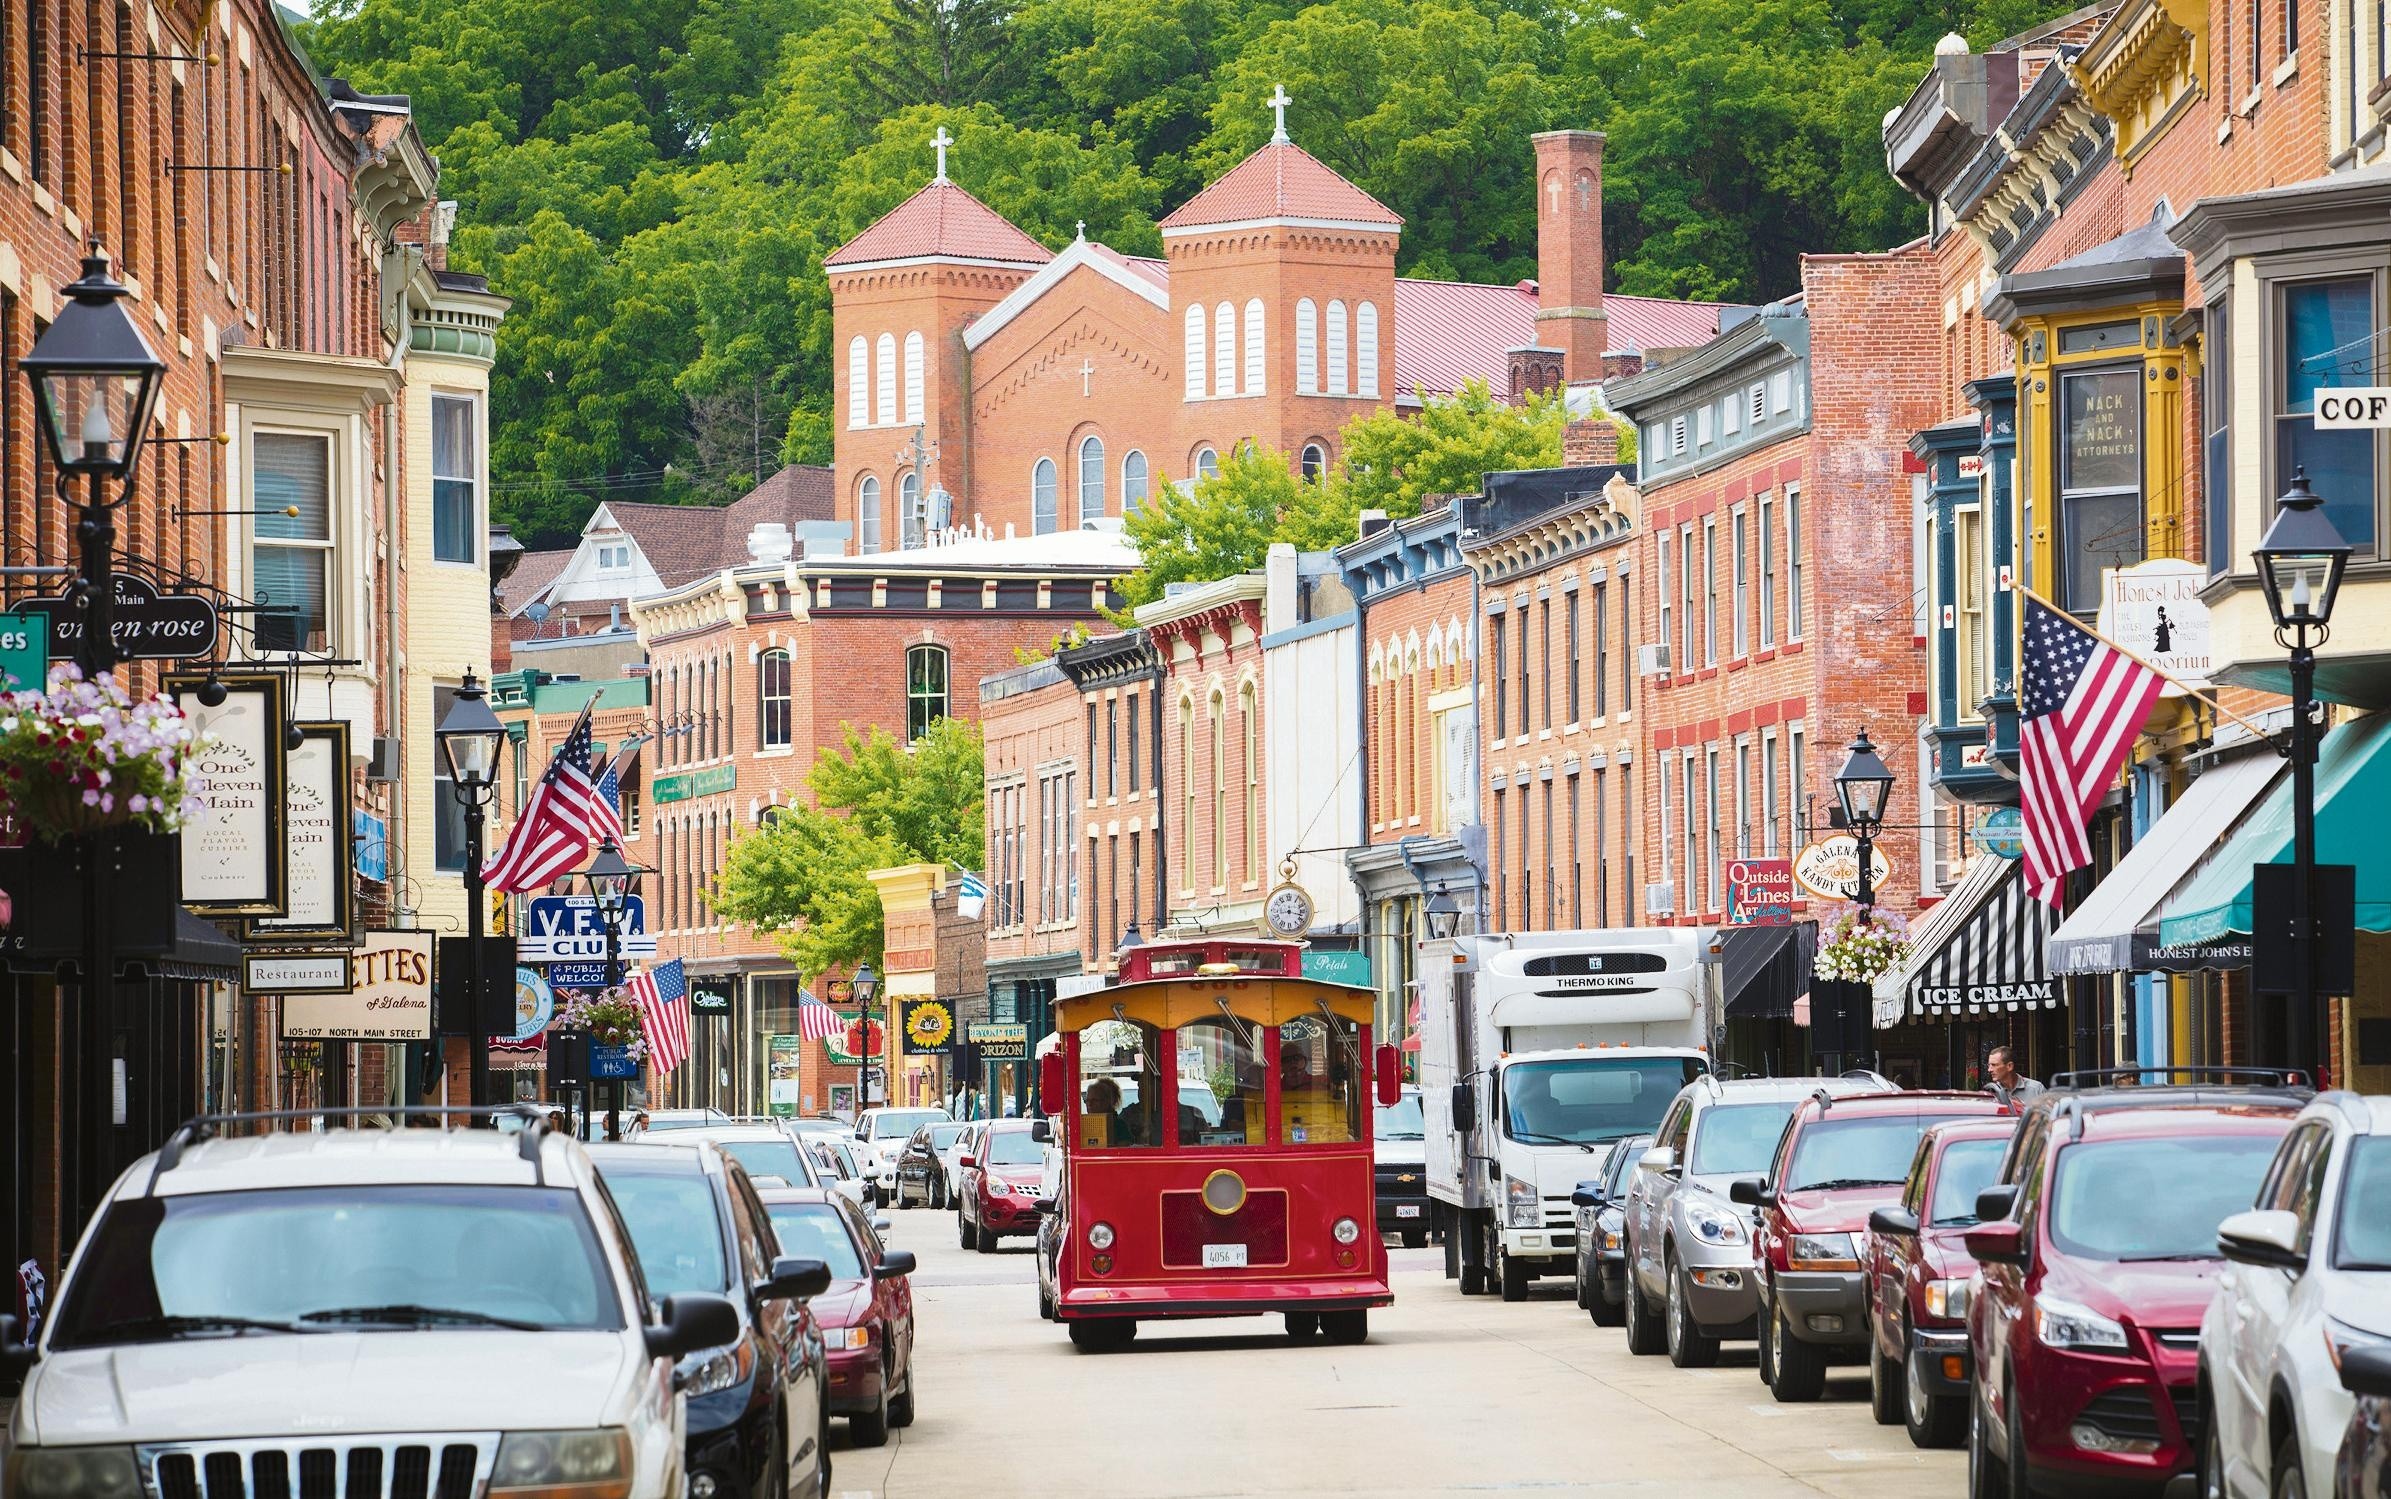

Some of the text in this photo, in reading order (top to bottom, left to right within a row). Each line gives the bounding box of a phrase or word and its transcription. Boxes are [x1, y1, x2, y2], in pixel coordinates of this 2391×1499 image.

[2086, 395, 2123, 411] NACK
[2321, 397, 2388, 420] COF
[2096, 413, 2114, 423] AND
[2087, 426, 2123, 442] NACK
[2077, 444, 2135, 457] ATTORNEYS
[2117, 579, 2200, 602] Honest Joh
[114, 594, 145, 606] Main
[151, 619, 205, 638] rose
[0, 630, 27, 650] es
[200, 761, 247, 774] One
[287, 818, 332, 827] even
[288, 832, 323, 843] ain
[1816, 846, 1859, 864] GALENA
[1729, 862, 1790, 884] Outside
[1801, 865, 1885, 893] KANDY KITEN
[1742, 882, 1790, 903] Lines
[1730, 902, 1759, 924] ART
[552, 941, 622, 955] CLU
[2149, 949, 2197, 960] HONEST
[2200, 947, 2240, 959] JOHN'S
[1314, 956, 1348, 971] Petals
[256, 968, 339, 980] Restaurant
[556, 974, 604, 983] WELCO
[1557, 976, 1634, 988] THERMO KING
[1923, 983, 2053, 1005] ICE CREAM
[367, 996, 427, 1009] of Galena
[288, 1028, 422, 1038] 105-107 NORTH MAIN STREET
[970, 1027, 1025, 1038] BEYOND THE
[980, 1044, 1024, 1056] ORIZON
[1210, 1252, 1231, 1262] 4056
